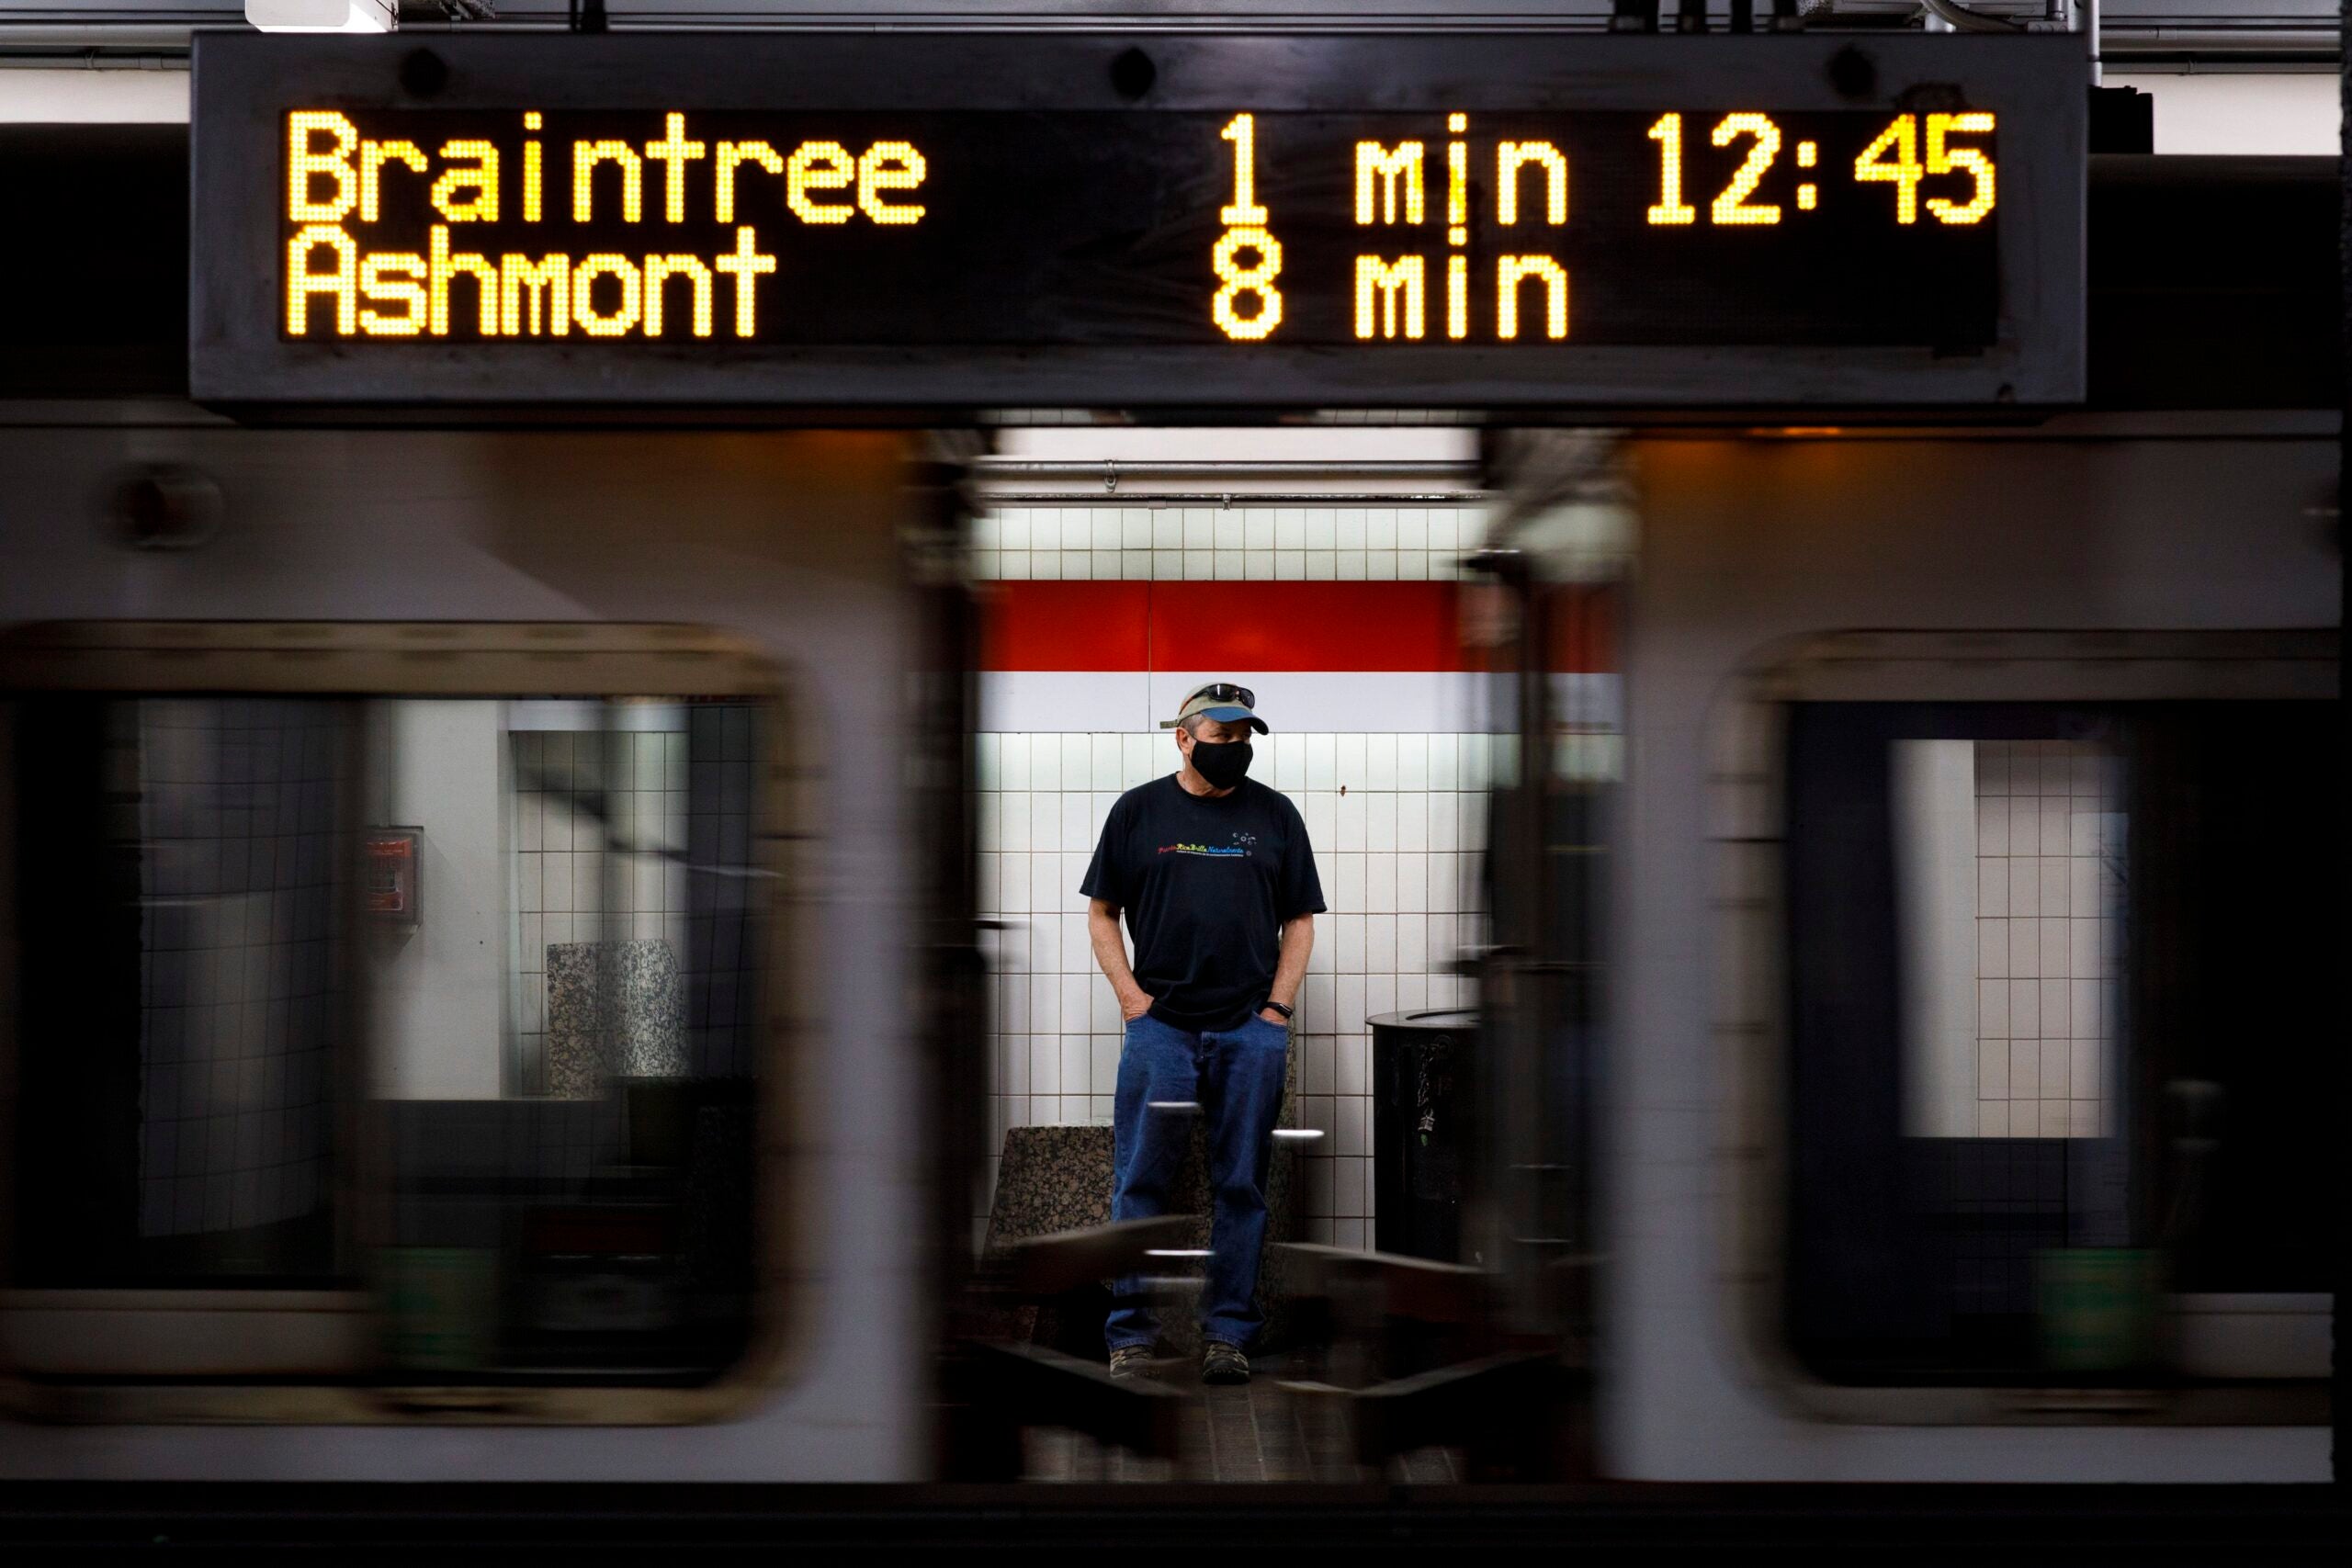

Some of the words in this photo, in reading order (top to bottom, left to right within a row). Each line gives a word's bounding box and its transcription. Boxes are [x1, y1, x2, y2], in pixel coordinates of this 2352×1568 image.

[287, 110, 927, 223] Braintree
[1218, 112, 1270, 226] 1
[1353, 112, 1569, 226] min
[286, 224, 778, 338] Ashmont
[1211, 226, 1284, 341] 8
[1353, 226, 1569, 340] min
